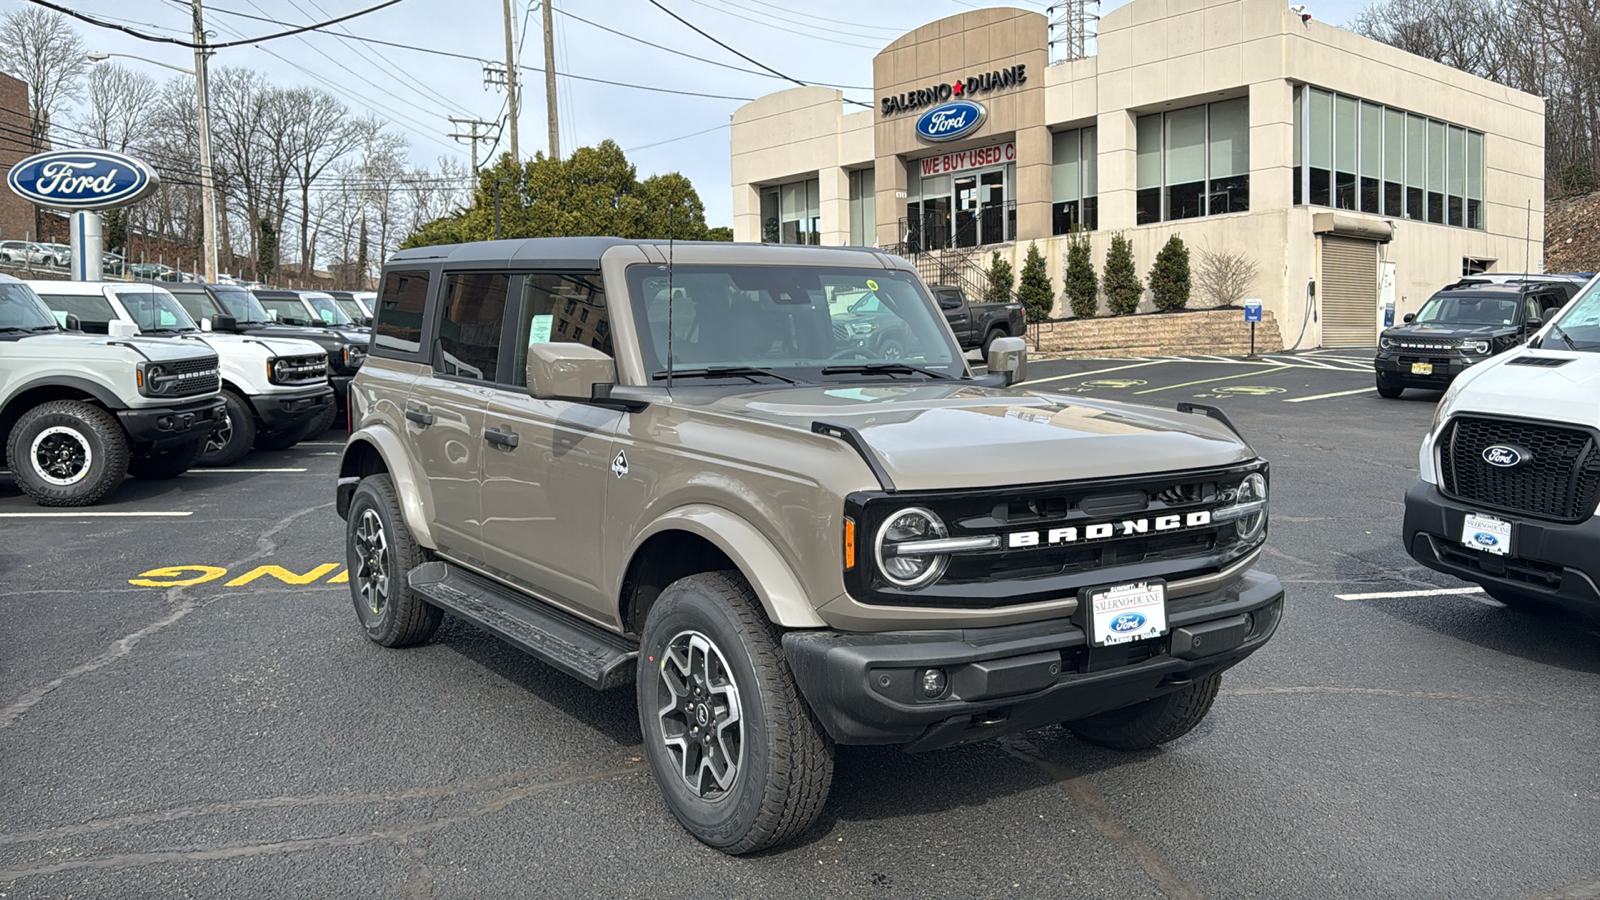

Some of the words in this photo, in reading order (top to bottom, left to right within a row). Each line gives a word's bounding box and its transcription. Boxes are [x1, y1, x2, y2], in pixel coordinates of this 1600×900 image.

[881, 83, 951, 115] SALERNO
[966, 64, 1027, 93] DUANE
[928, 109, 967, 134] Ford
[921, 158, 940, 175] WE
[943, 150, 966, 171] BUY
[969, 146, 1001, 167] USED
[1005, 143, 1016, 160] C
[36, 161, 118, 195] Ford
[178, 369, 217, 379] BRONCO
[1488, 448, 1514, 463] Ford
[1009, 511, 1210, 547] BRONCO
[1095, 597, 1130, 612] SALERNO
[1133, 592, 1161, 605] DUANE
[1116, 615, 1140, 630] Ford
